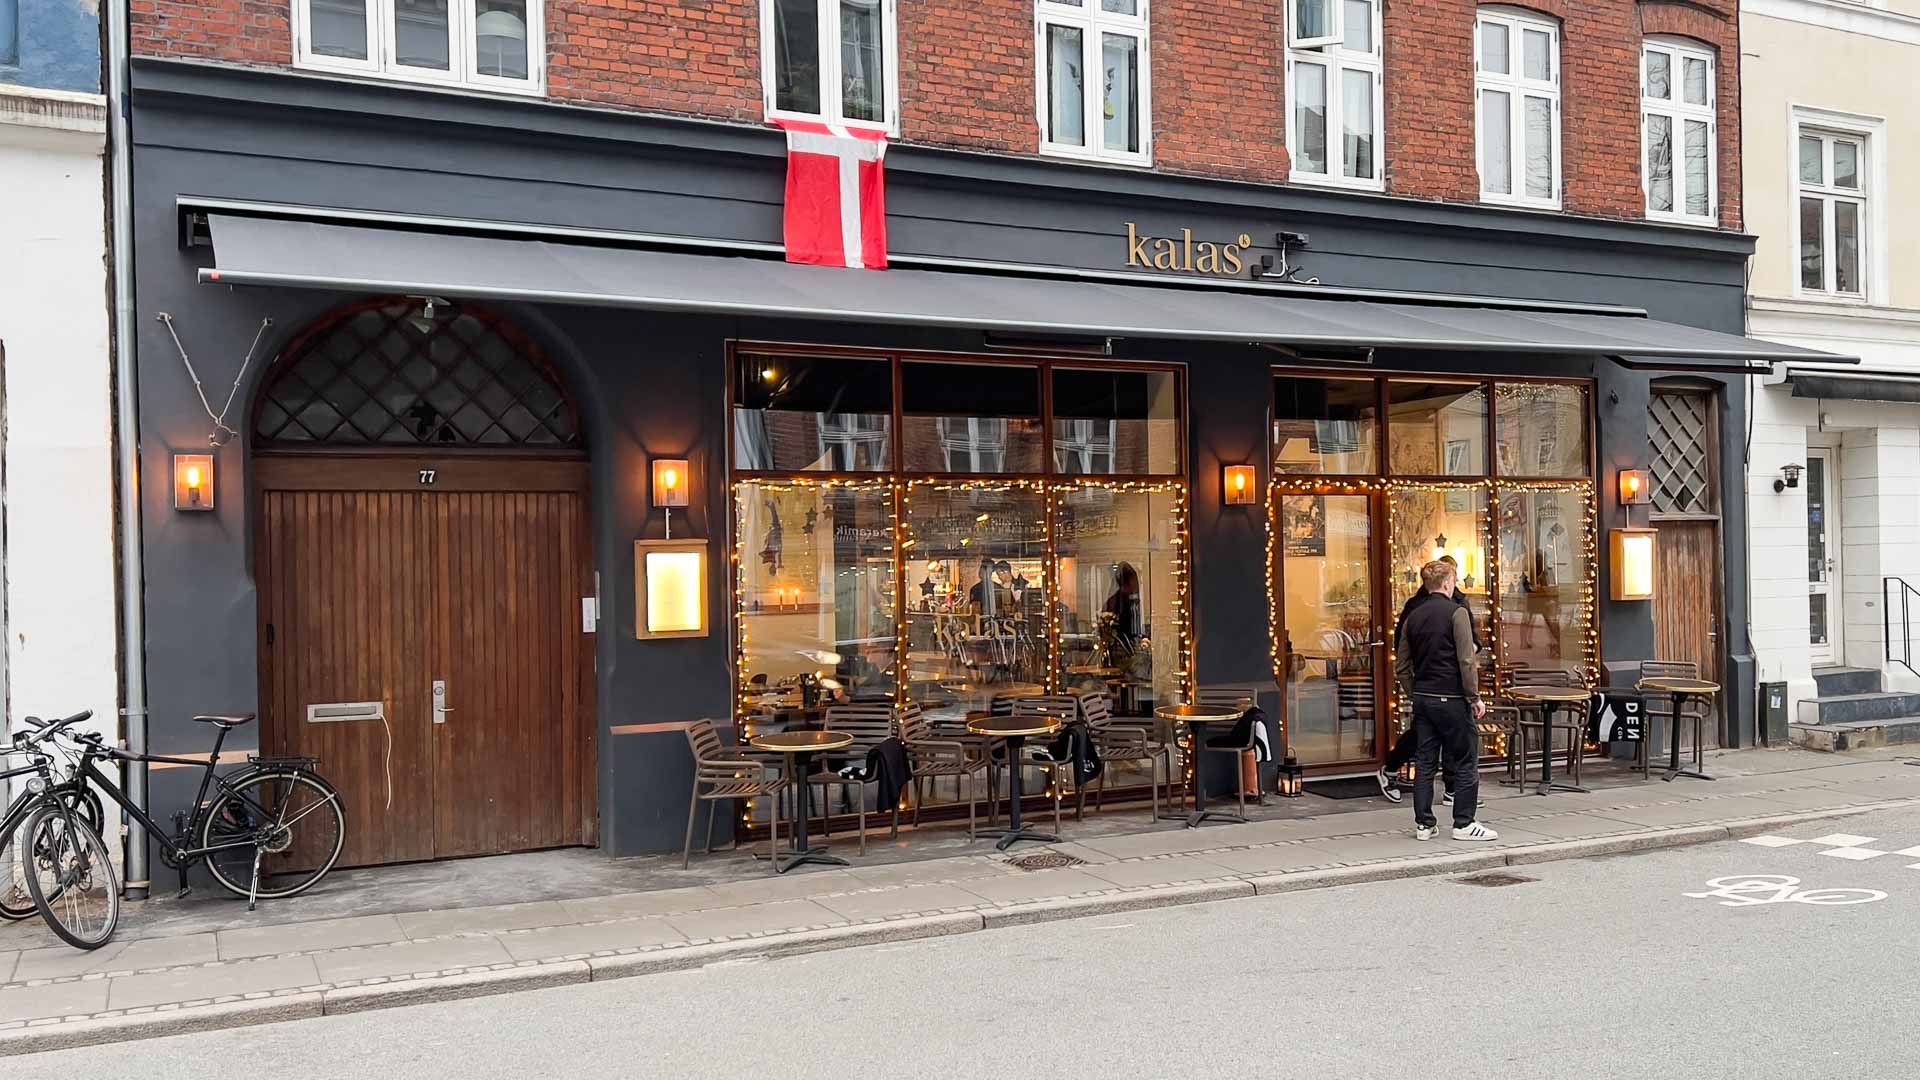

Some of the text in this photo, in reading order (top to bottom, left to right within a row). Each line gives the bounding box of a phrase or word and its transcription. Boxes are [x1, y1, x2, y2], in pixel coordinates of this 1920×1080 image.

[1123, 222, 1242, 275] kalas
[419, 470, 436, 483] 77
[935, 614, 1017, 641] kalas
